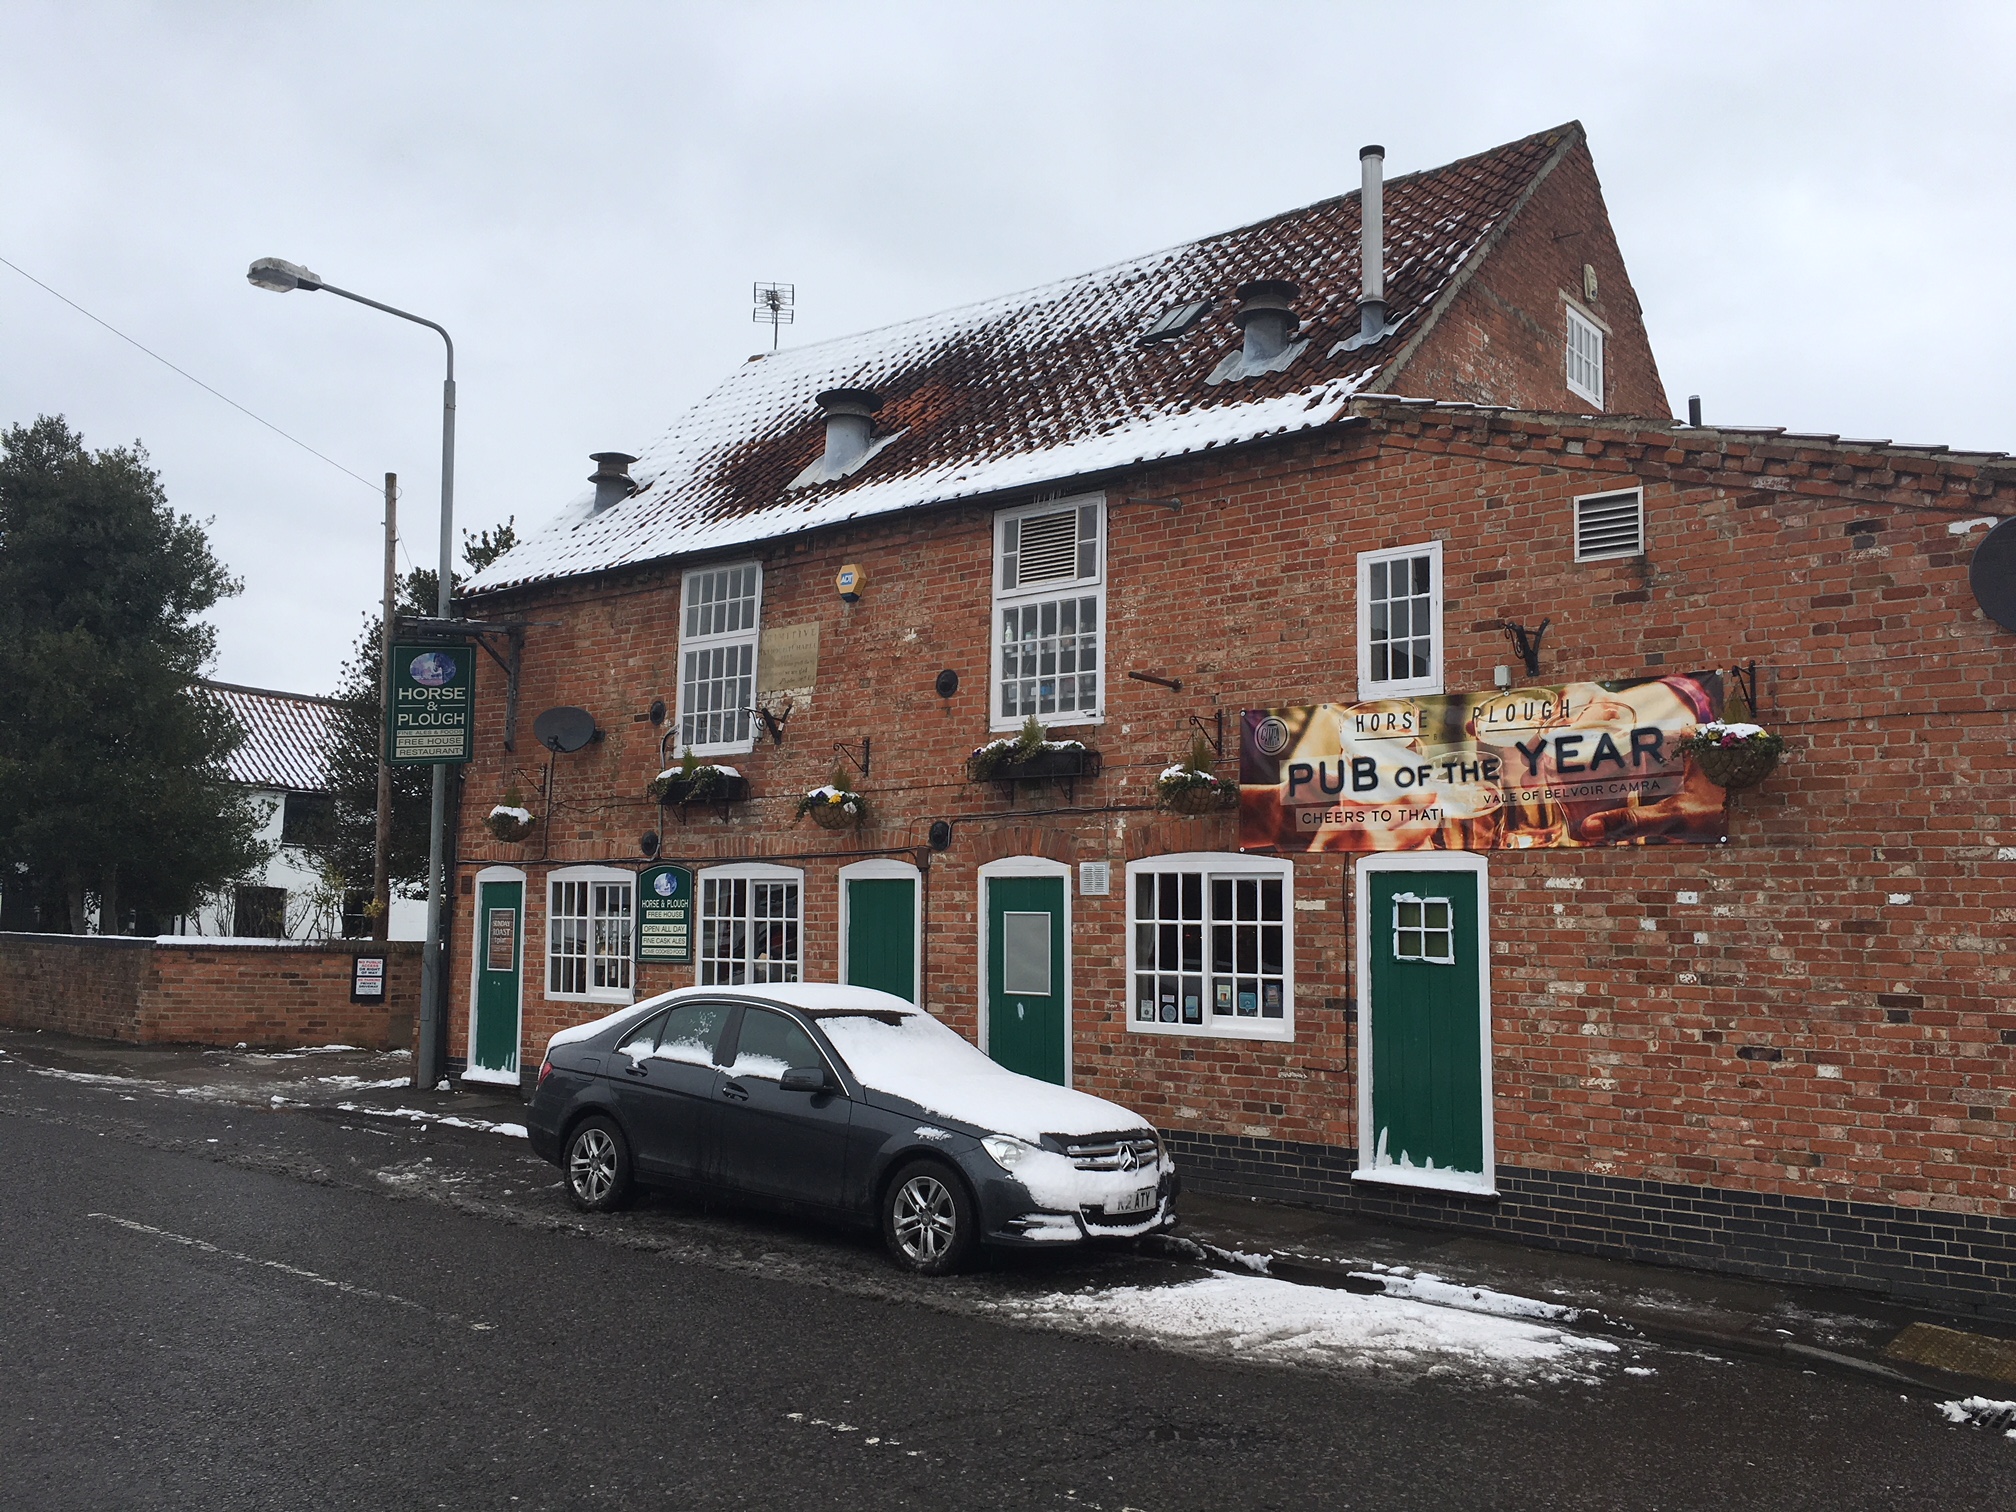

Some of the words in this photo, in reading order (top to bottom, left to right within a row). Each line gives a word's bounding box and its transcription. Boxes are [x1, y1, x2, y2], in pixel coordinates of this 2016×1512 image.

[840, 574, 853, 584] ADT
[398, 687, 466, 700] HORSE
[426, 702, 438, 711] &
[398, 713, 465, 726] PLOUGH
[1356, 710, 1428, 732] HORSE
[1472, 699, 1570, 723] PLOUGH
[1288, 757, 1379, 797] PUB
[1394, 765, 1433, 788] OF
[1442, 758, 1499, 784] THE
[1515, 726, 1666, 776] YEAR
[1483, 791, 1517, 804] VALE
[1521, 790, 1539, 801] OF
[1544, 784, 1604, 799] BELVOIR
[1609, 779, 1661, 794] CAMRA
[1302, 811, 1365, 824] CHEERS
[1371, 810, 1392, 822] TO
[1398, 808, 1444, 822] THAT!
[642, 899, 660, 908] HORSE
[661, 899, 665, 908] &
[667, 899, 688, 908] PLOUGH
[1135, 1191, 1150, 1209] ATY
